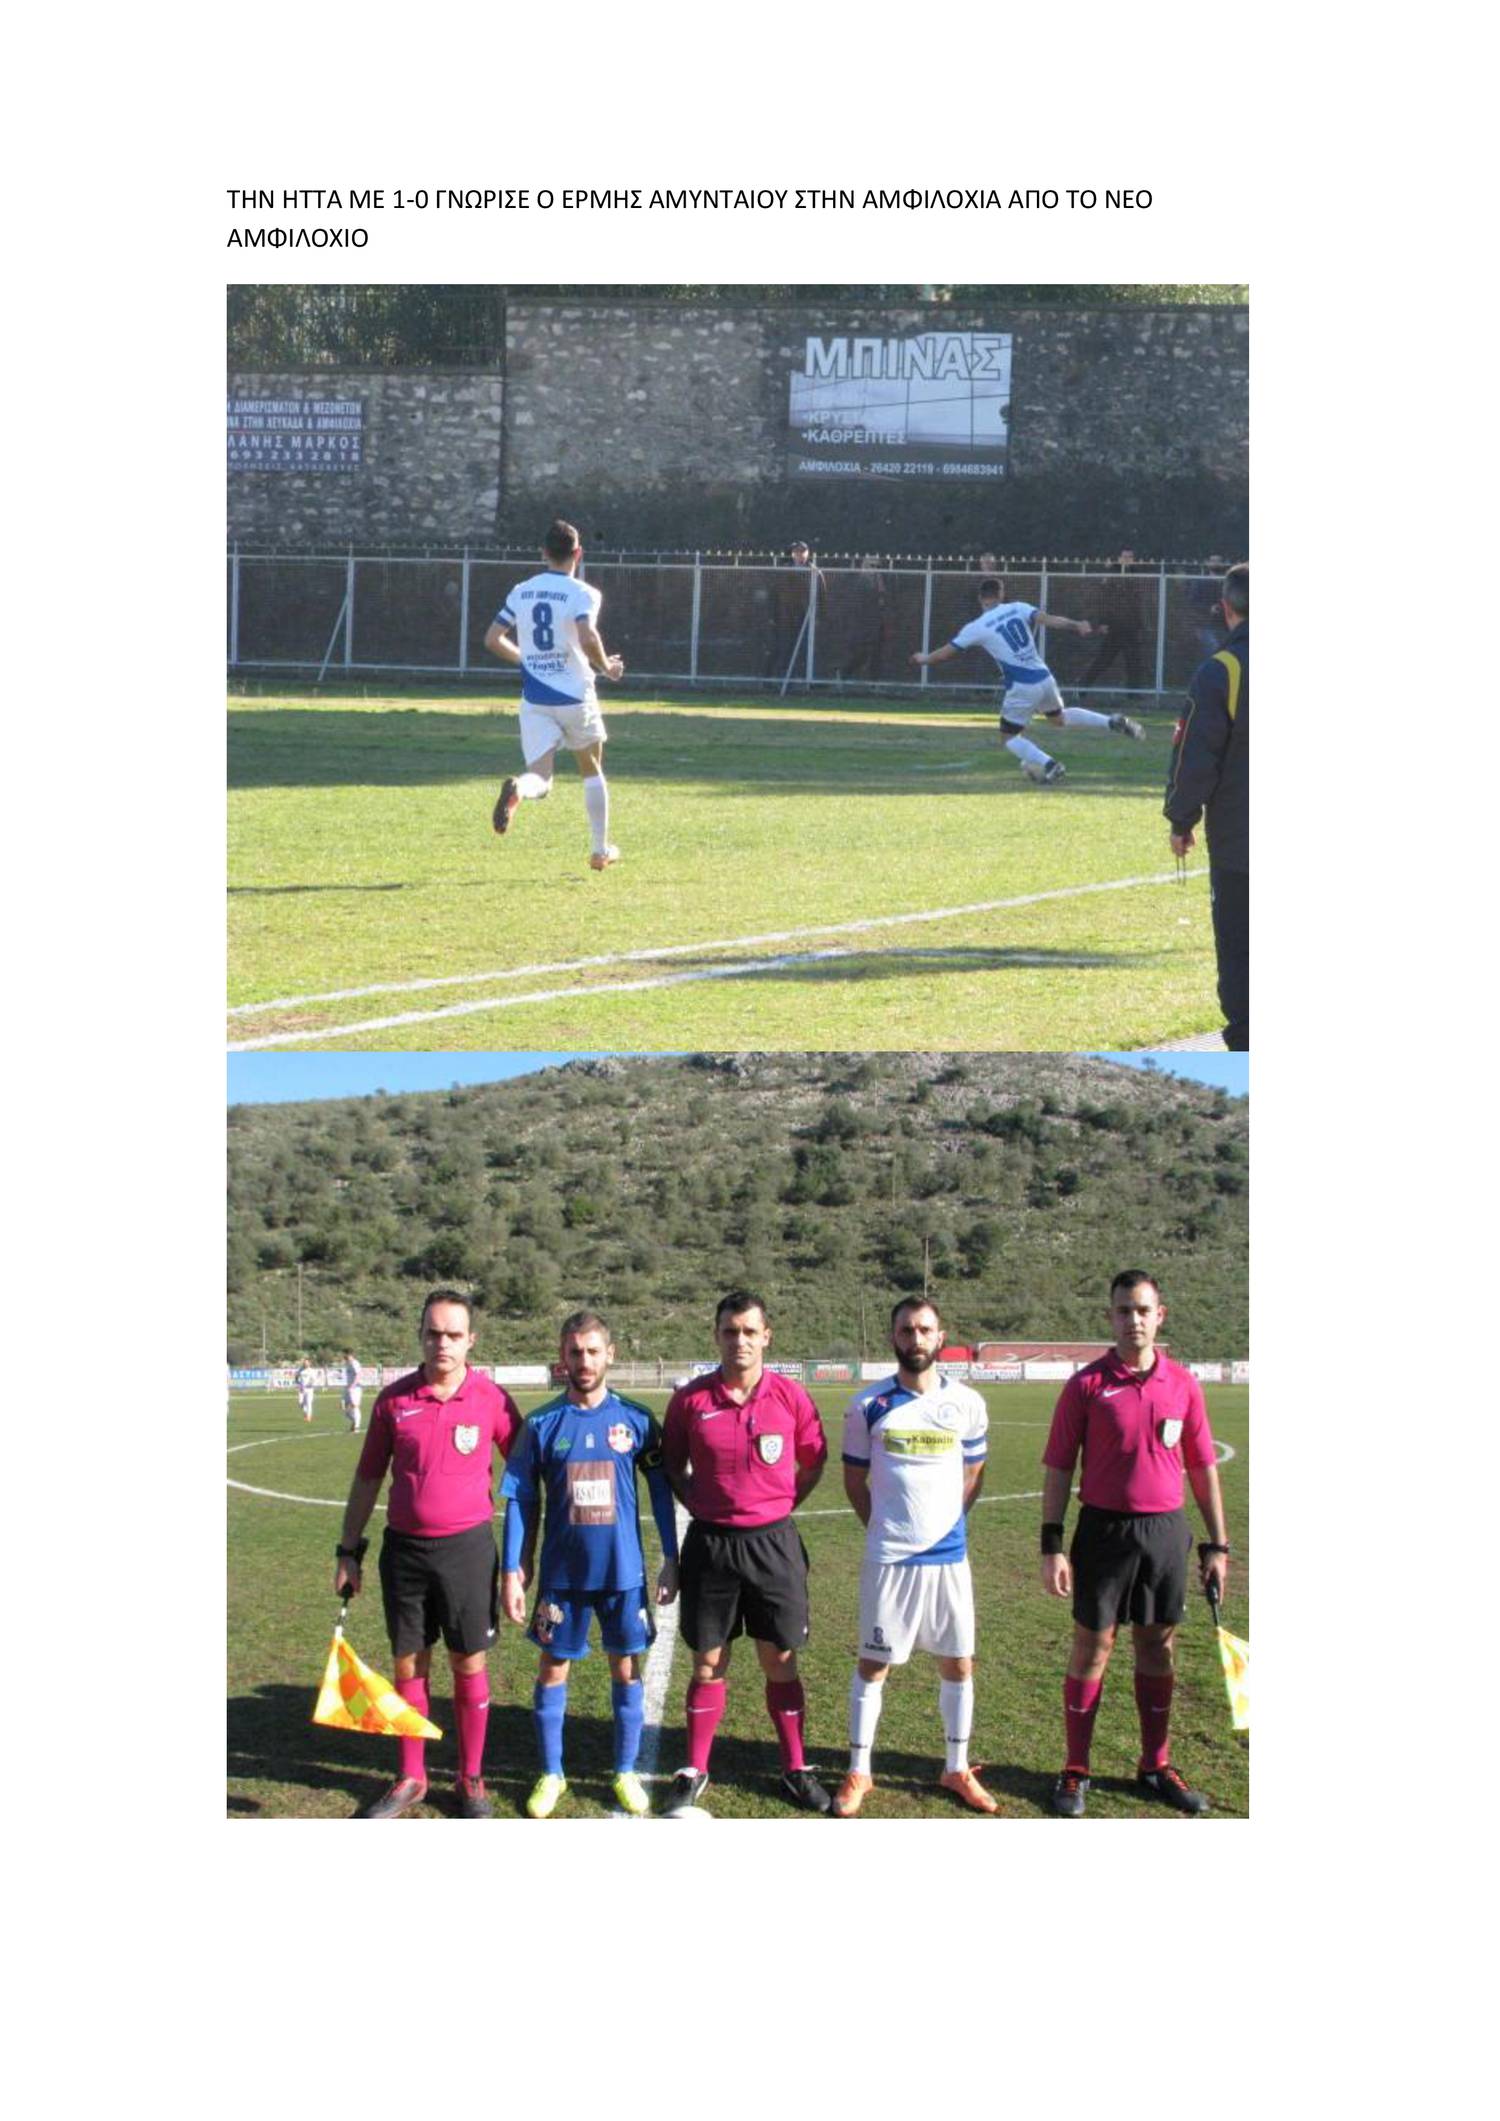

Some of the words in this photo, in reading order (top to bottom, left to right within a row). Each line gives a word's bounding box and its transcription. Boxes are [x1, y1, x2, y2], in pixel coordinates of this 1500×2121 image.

[227, 189, 274, 209] ΤΗΝ
[283, 189, 343, 209] ΗΤΤΑ
[349, 189, 385, 209] ΜΕ
[393, 189, 429, 209] 1-0
[436, 189, 530, 209] ΓΝΩΡΙΣΕ
[536, 189, 554, 209] Ο
[562, 189, 643, 209] ΕΡΜΗΣ
[648, 189, 788, 209] ΑΜΥΝΤΑΙΟΥ
[794, 189, 855, 209] ΣΤΗΝ
[862, 189, 1002, 210] ΑΜΦΙΛΟΧΙΑ
[1007, 189, 1059, 209] ΑΠΟ
[1065, 189, 1097, 209] ΤΟ
[1105, 189, 1153, 209] ΝΕΟ
[226, 227, 369, 249] ΑΜΦΙΛΟΧΙΟ
[804, 335, 1001, 381] ΜΠΙΝΑΣ
[291, 435, 360, 450] ΜΑΡΚΟΣ
[532, 601, 554, 651] 8
[995, 617, 1030, 653] 10
